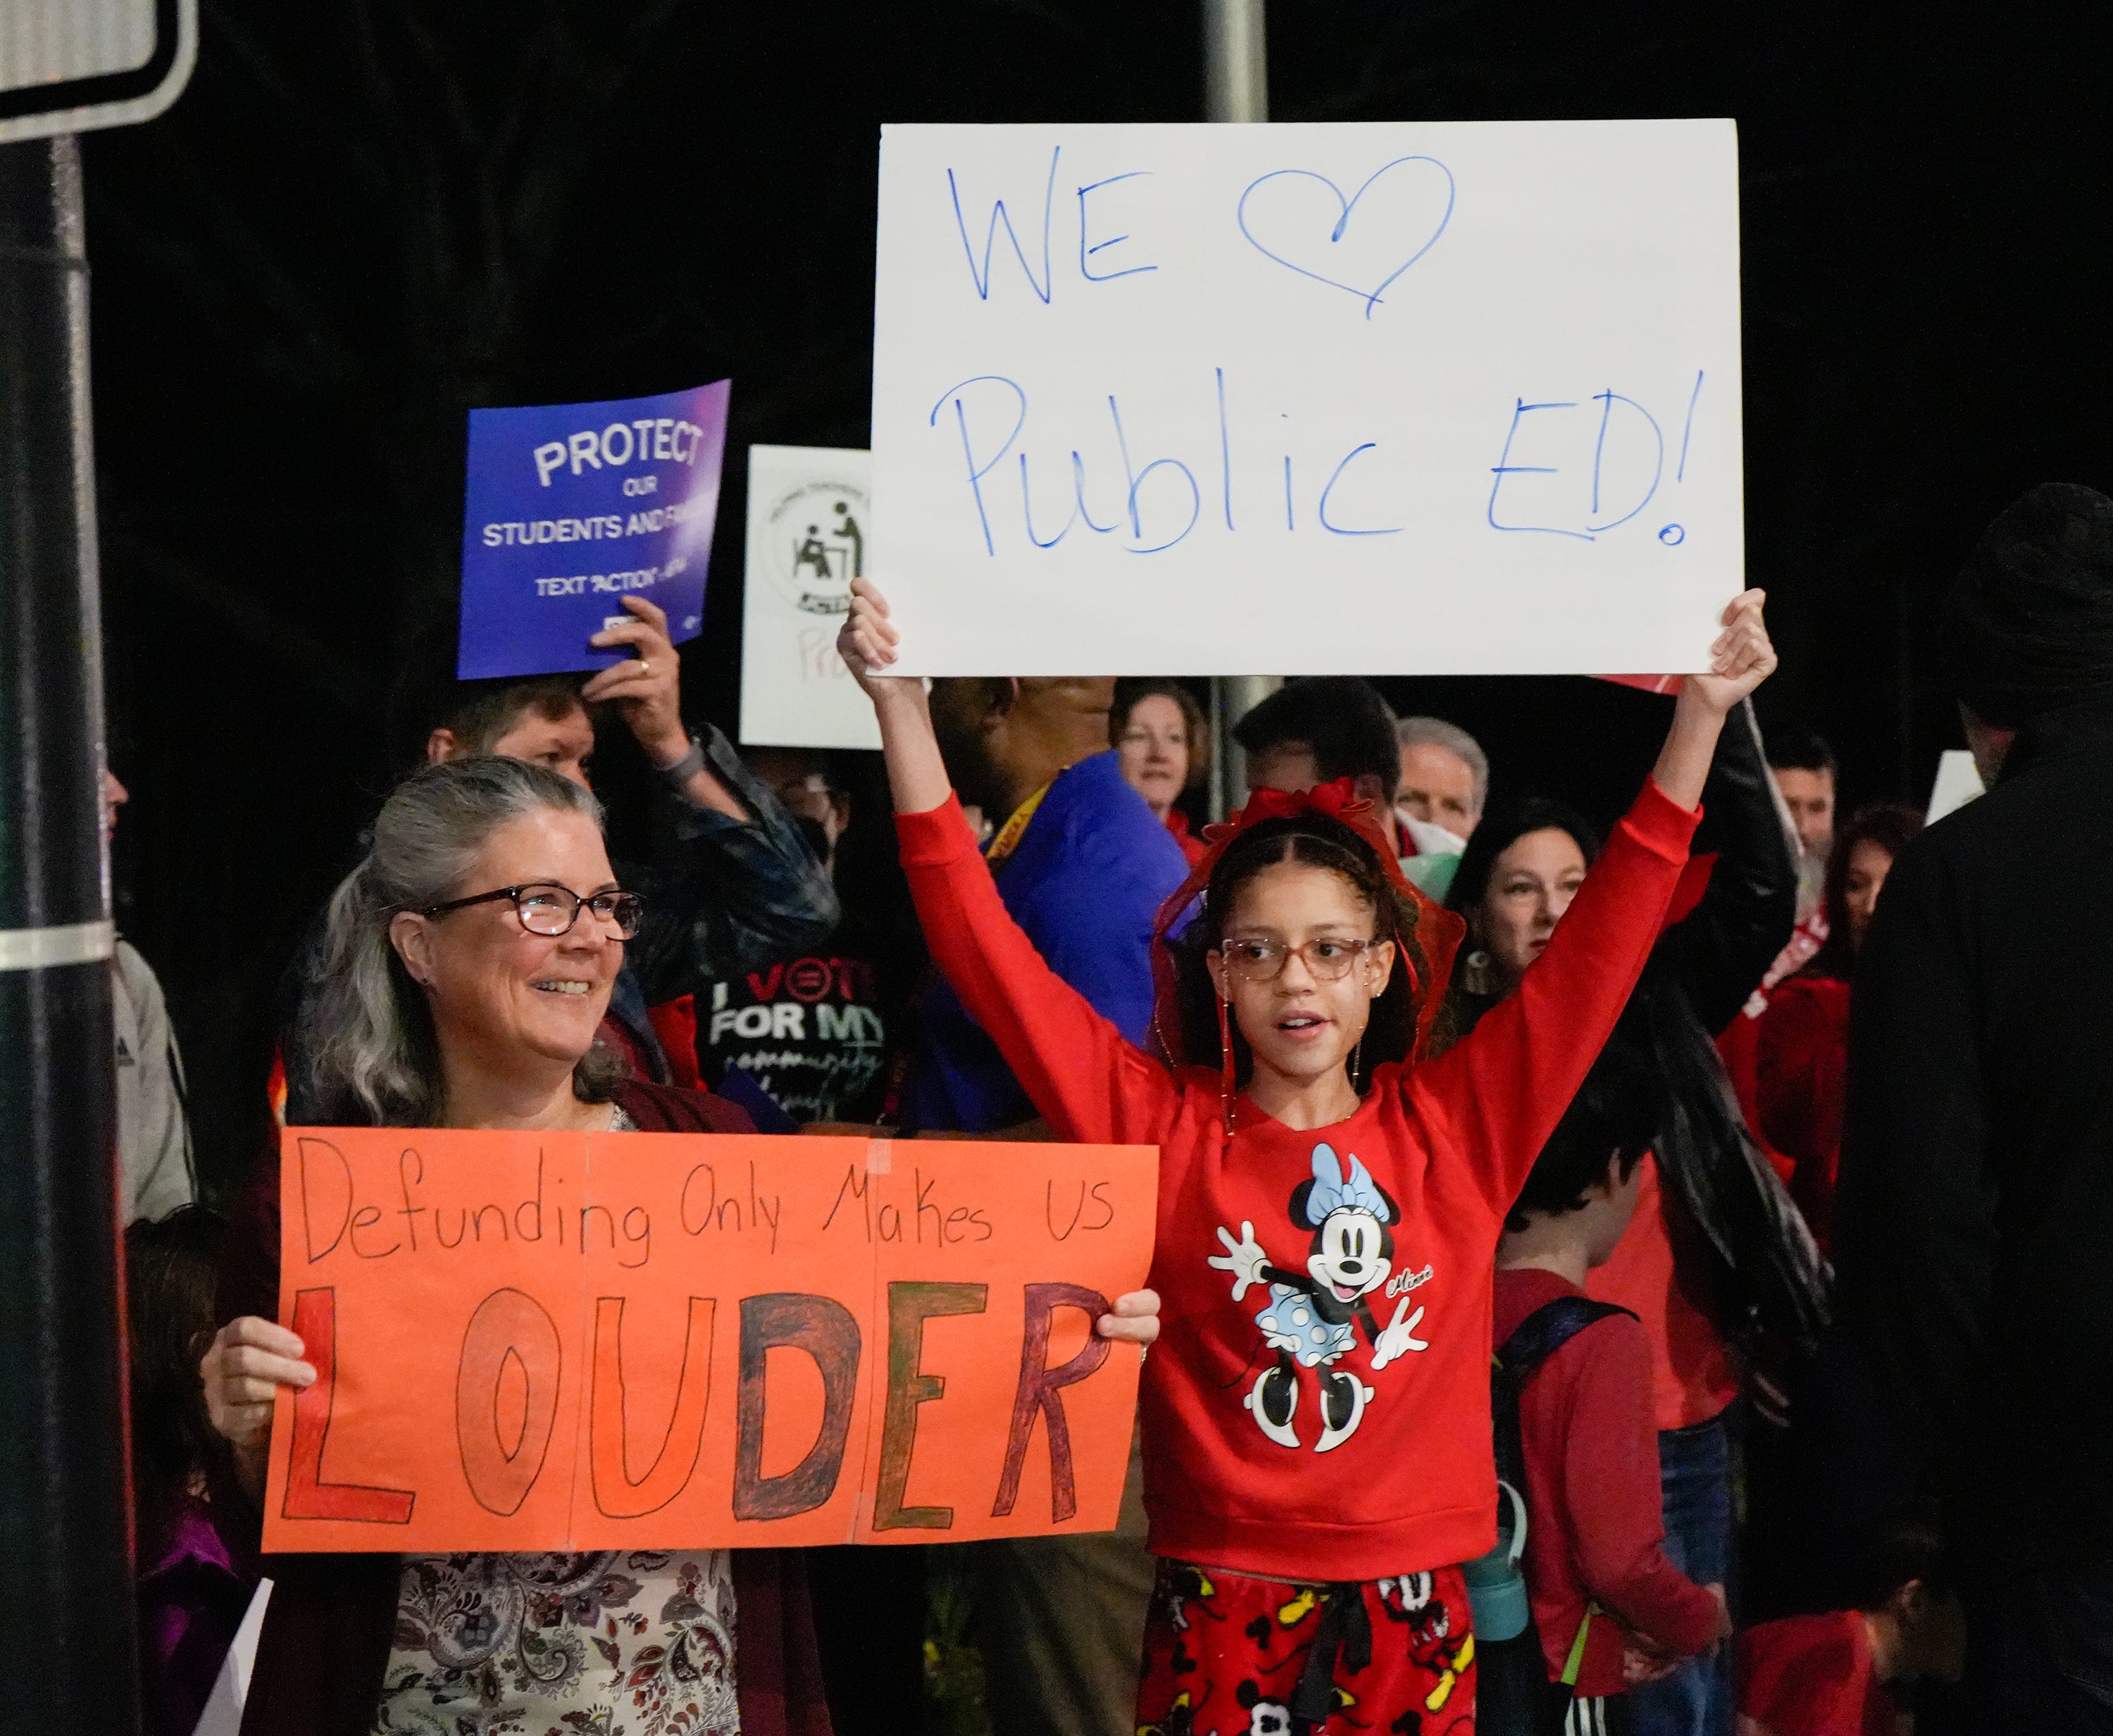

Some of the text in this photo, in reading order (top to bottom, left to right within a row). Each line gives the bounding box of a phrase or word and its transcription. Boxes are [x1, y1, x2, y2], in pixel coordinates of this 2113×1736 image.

[947, 144, 1159, 304] WE
[533, 418, 704, 487] PROTECT
[623, 475, 659, 497] OUR
[930, 366, 1704, 557] Public ED!
[482, 514, 623, 547] STUDENTS
[535, 575, 587, 597] TEXT
[708, 1001, 806, 1047] FOR
[297, 1136, 652, 1269] Defunding
[680, 1160, 780, 1255] Only
[281, 1280, 1112, 1532] LOUDER
